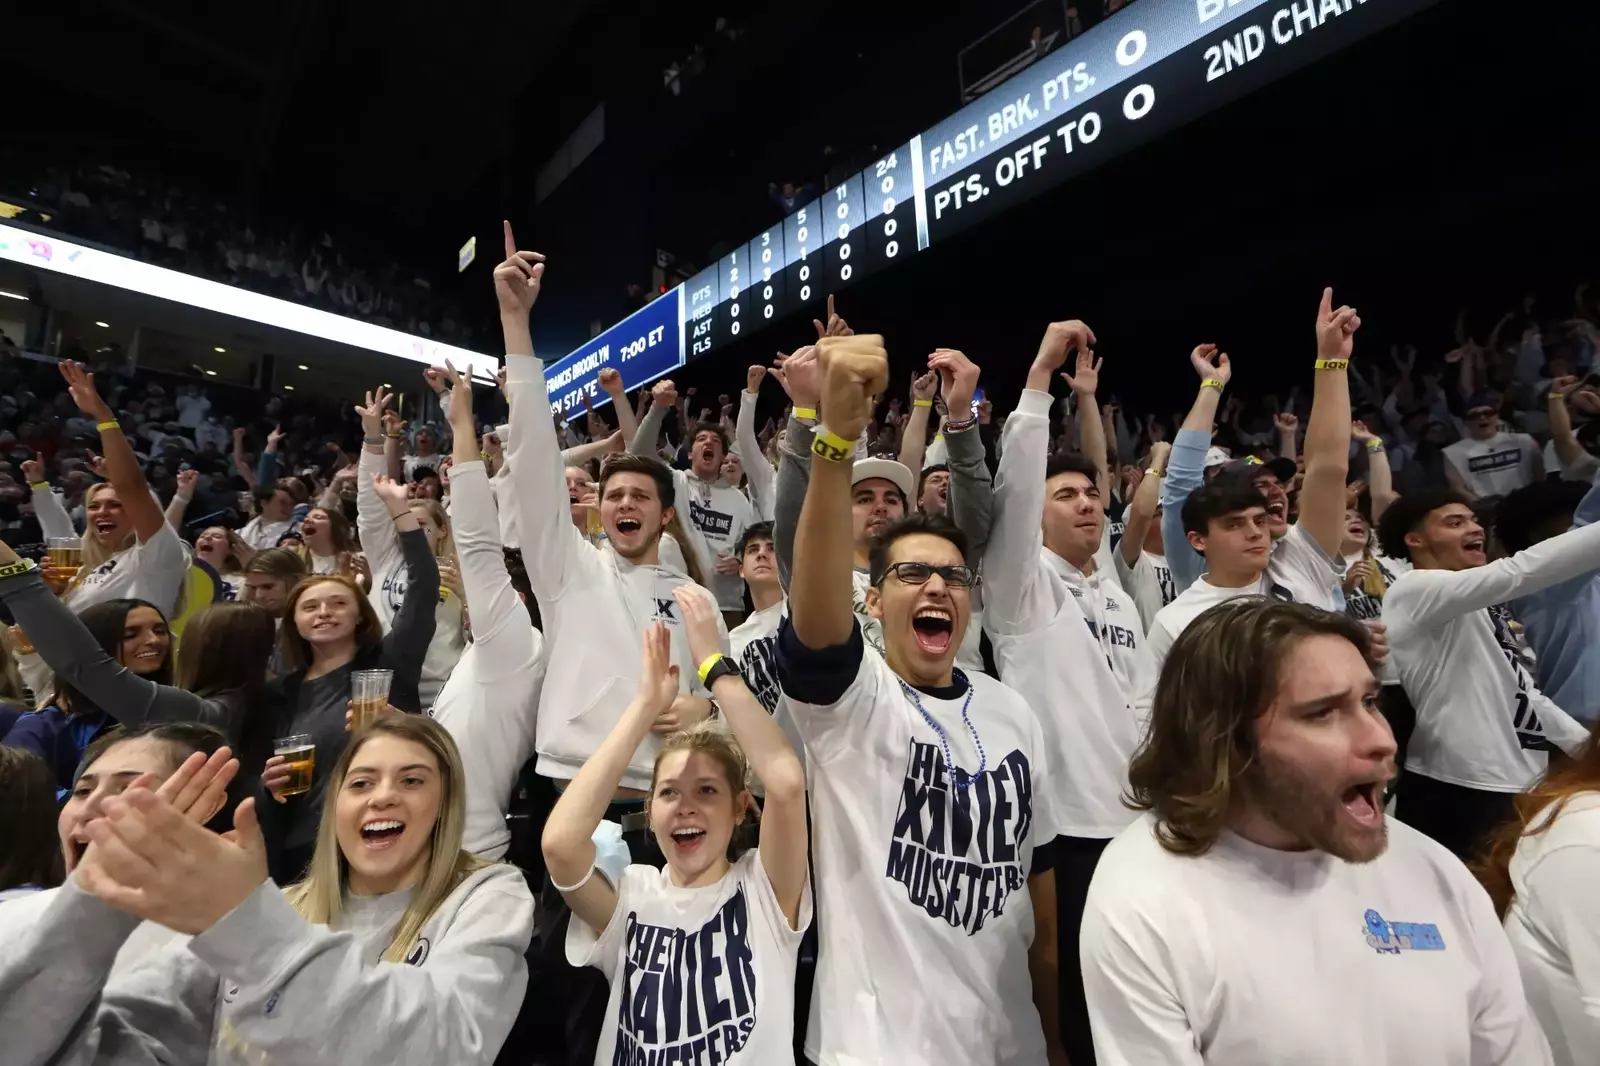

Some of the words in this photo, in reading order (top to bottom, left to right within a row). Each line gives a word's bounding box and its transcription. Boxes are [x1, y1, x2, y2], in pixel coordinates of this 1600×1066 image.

[1203, 24, 1266, 82] 2ND
[930, 124, 985, 175] FAST.
[988, 93, 1039, 142] BRK.
[1042, 61, 1096, 111] PTS.
[934, 173, 990, 219] PTS.
[995, 135, 1050, 186] OFF
[1056, 112, 1101, 154] TO
[731, 252, 737, 265] 1
[762, 232, 770, 246] 3
[797, 208, 807, 225] 5
[836, 184, 847, 200] 11
[876, 153, 898, 177] 24
[692, 285, 711, 306] PTS
[730, 267, 739, 282] 2
[692, 302, 712, 322] REB
[693, 318, 712, 339] AST
[546, 366, 572, 394] FRANCIS
[572, 344, 609, 380] BROOKLYN
[620, 336, 646, 362] 7:00
[648, 325, 665, 348] ET
[693, 337, 711, 355] FLS
[564, 379, 598, 411] STATE
[716, 518, 730, 529] ONE
